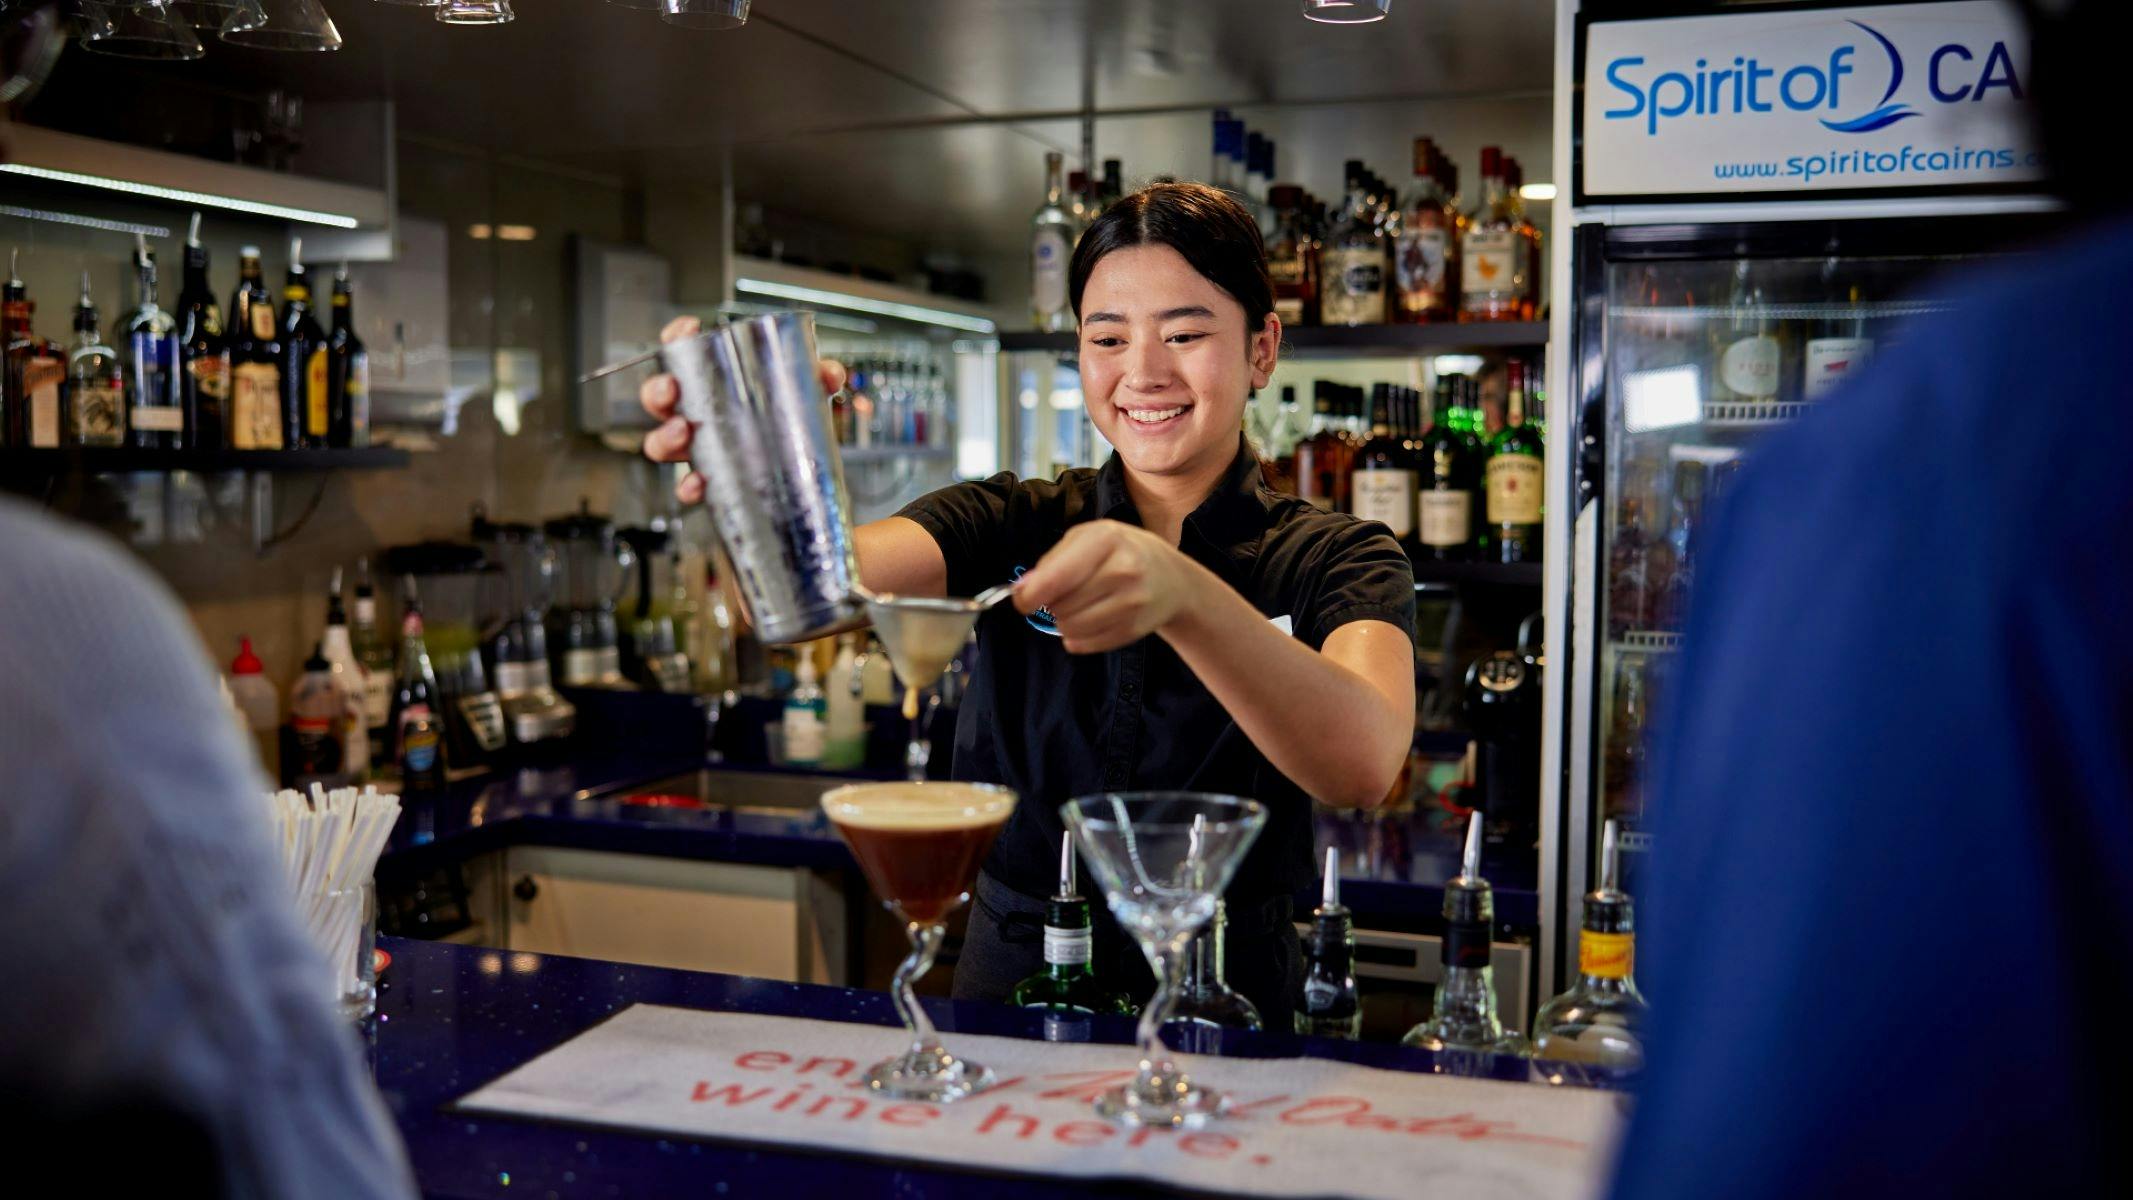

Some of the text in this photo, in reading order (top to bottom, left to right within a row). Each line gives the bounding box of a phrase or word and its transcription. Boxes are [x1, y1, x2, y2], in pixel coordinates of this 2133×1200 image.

[1928, 41, 2027, 104] CA
[691, 1079, 1274, 1165] wine here.
